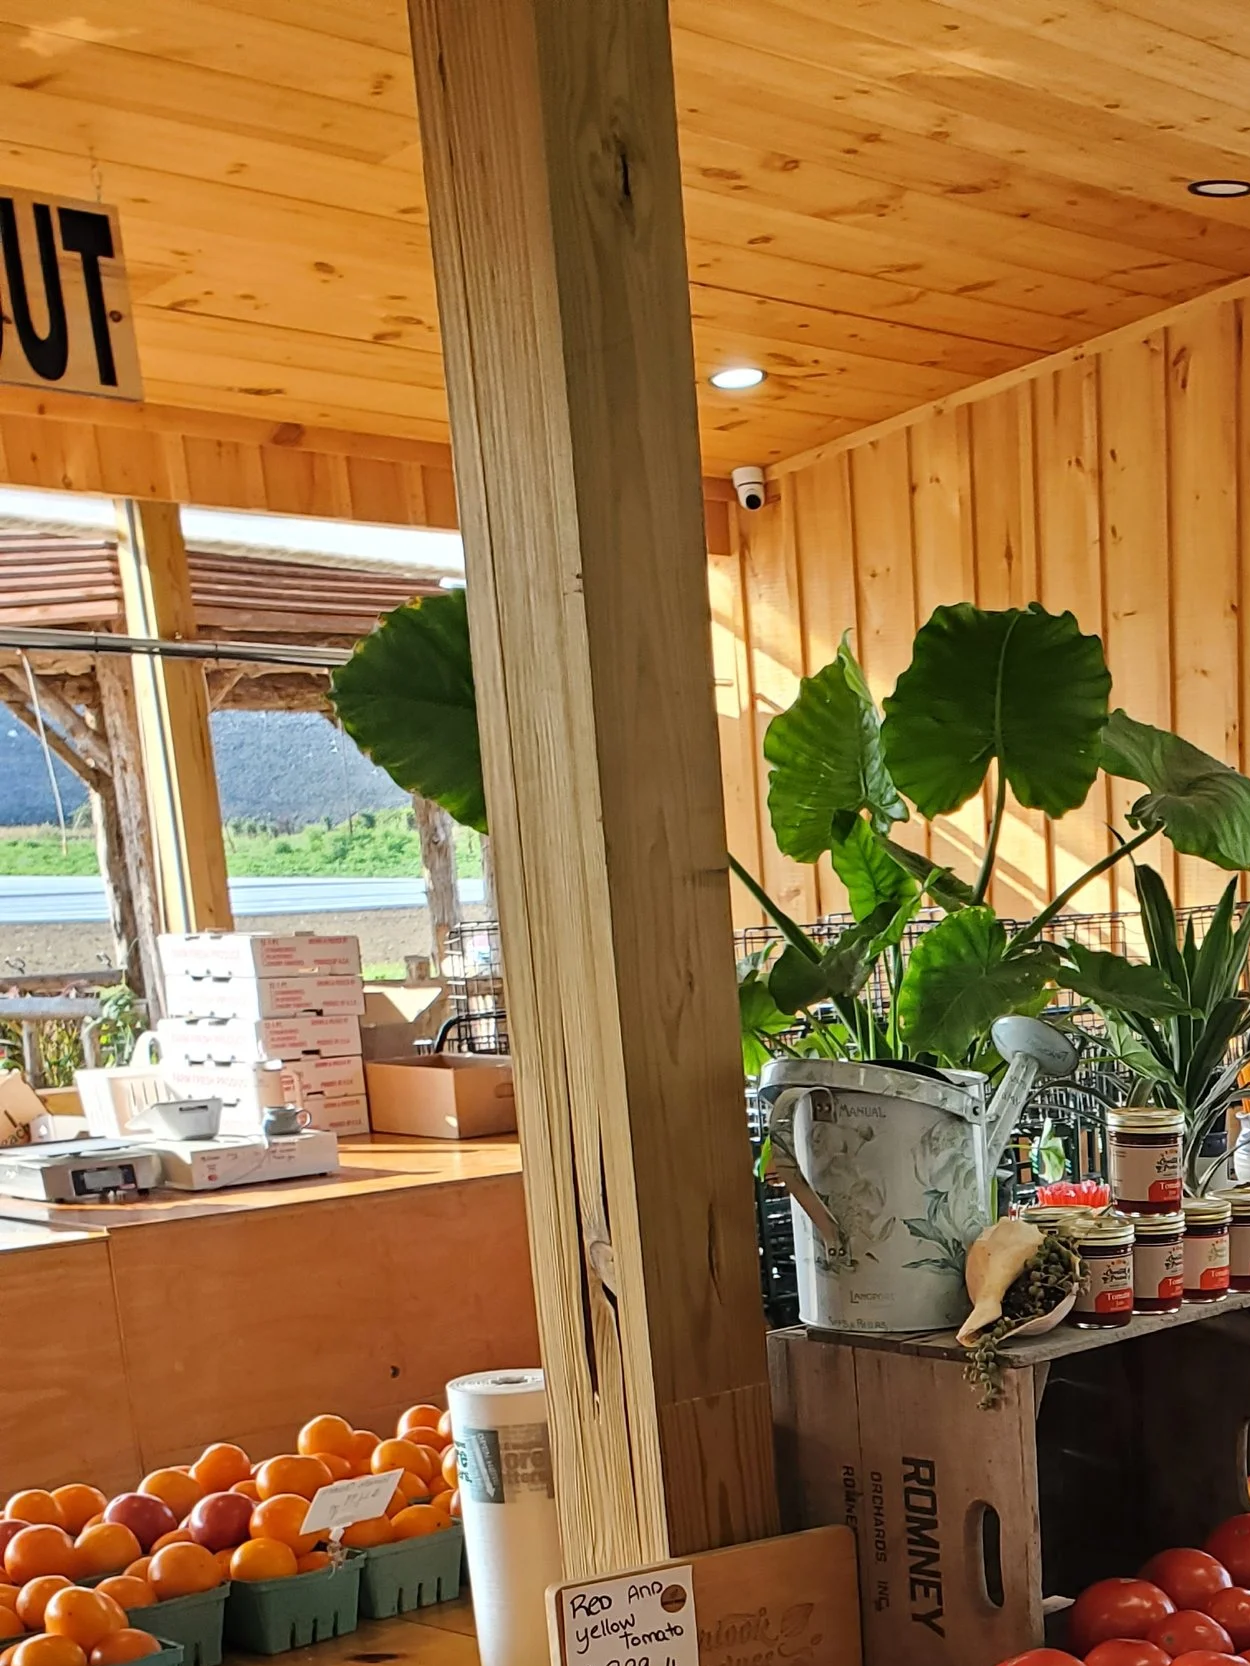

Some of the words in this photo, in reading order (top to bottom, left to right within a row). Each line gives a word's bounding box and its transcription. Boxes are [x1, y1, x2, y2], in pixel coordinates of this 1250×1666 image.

[0, 197, 118, 387] UT
[576, 1613, 635, 1654] yellow
[901, 1456, 945, 1639] ROMNEY
